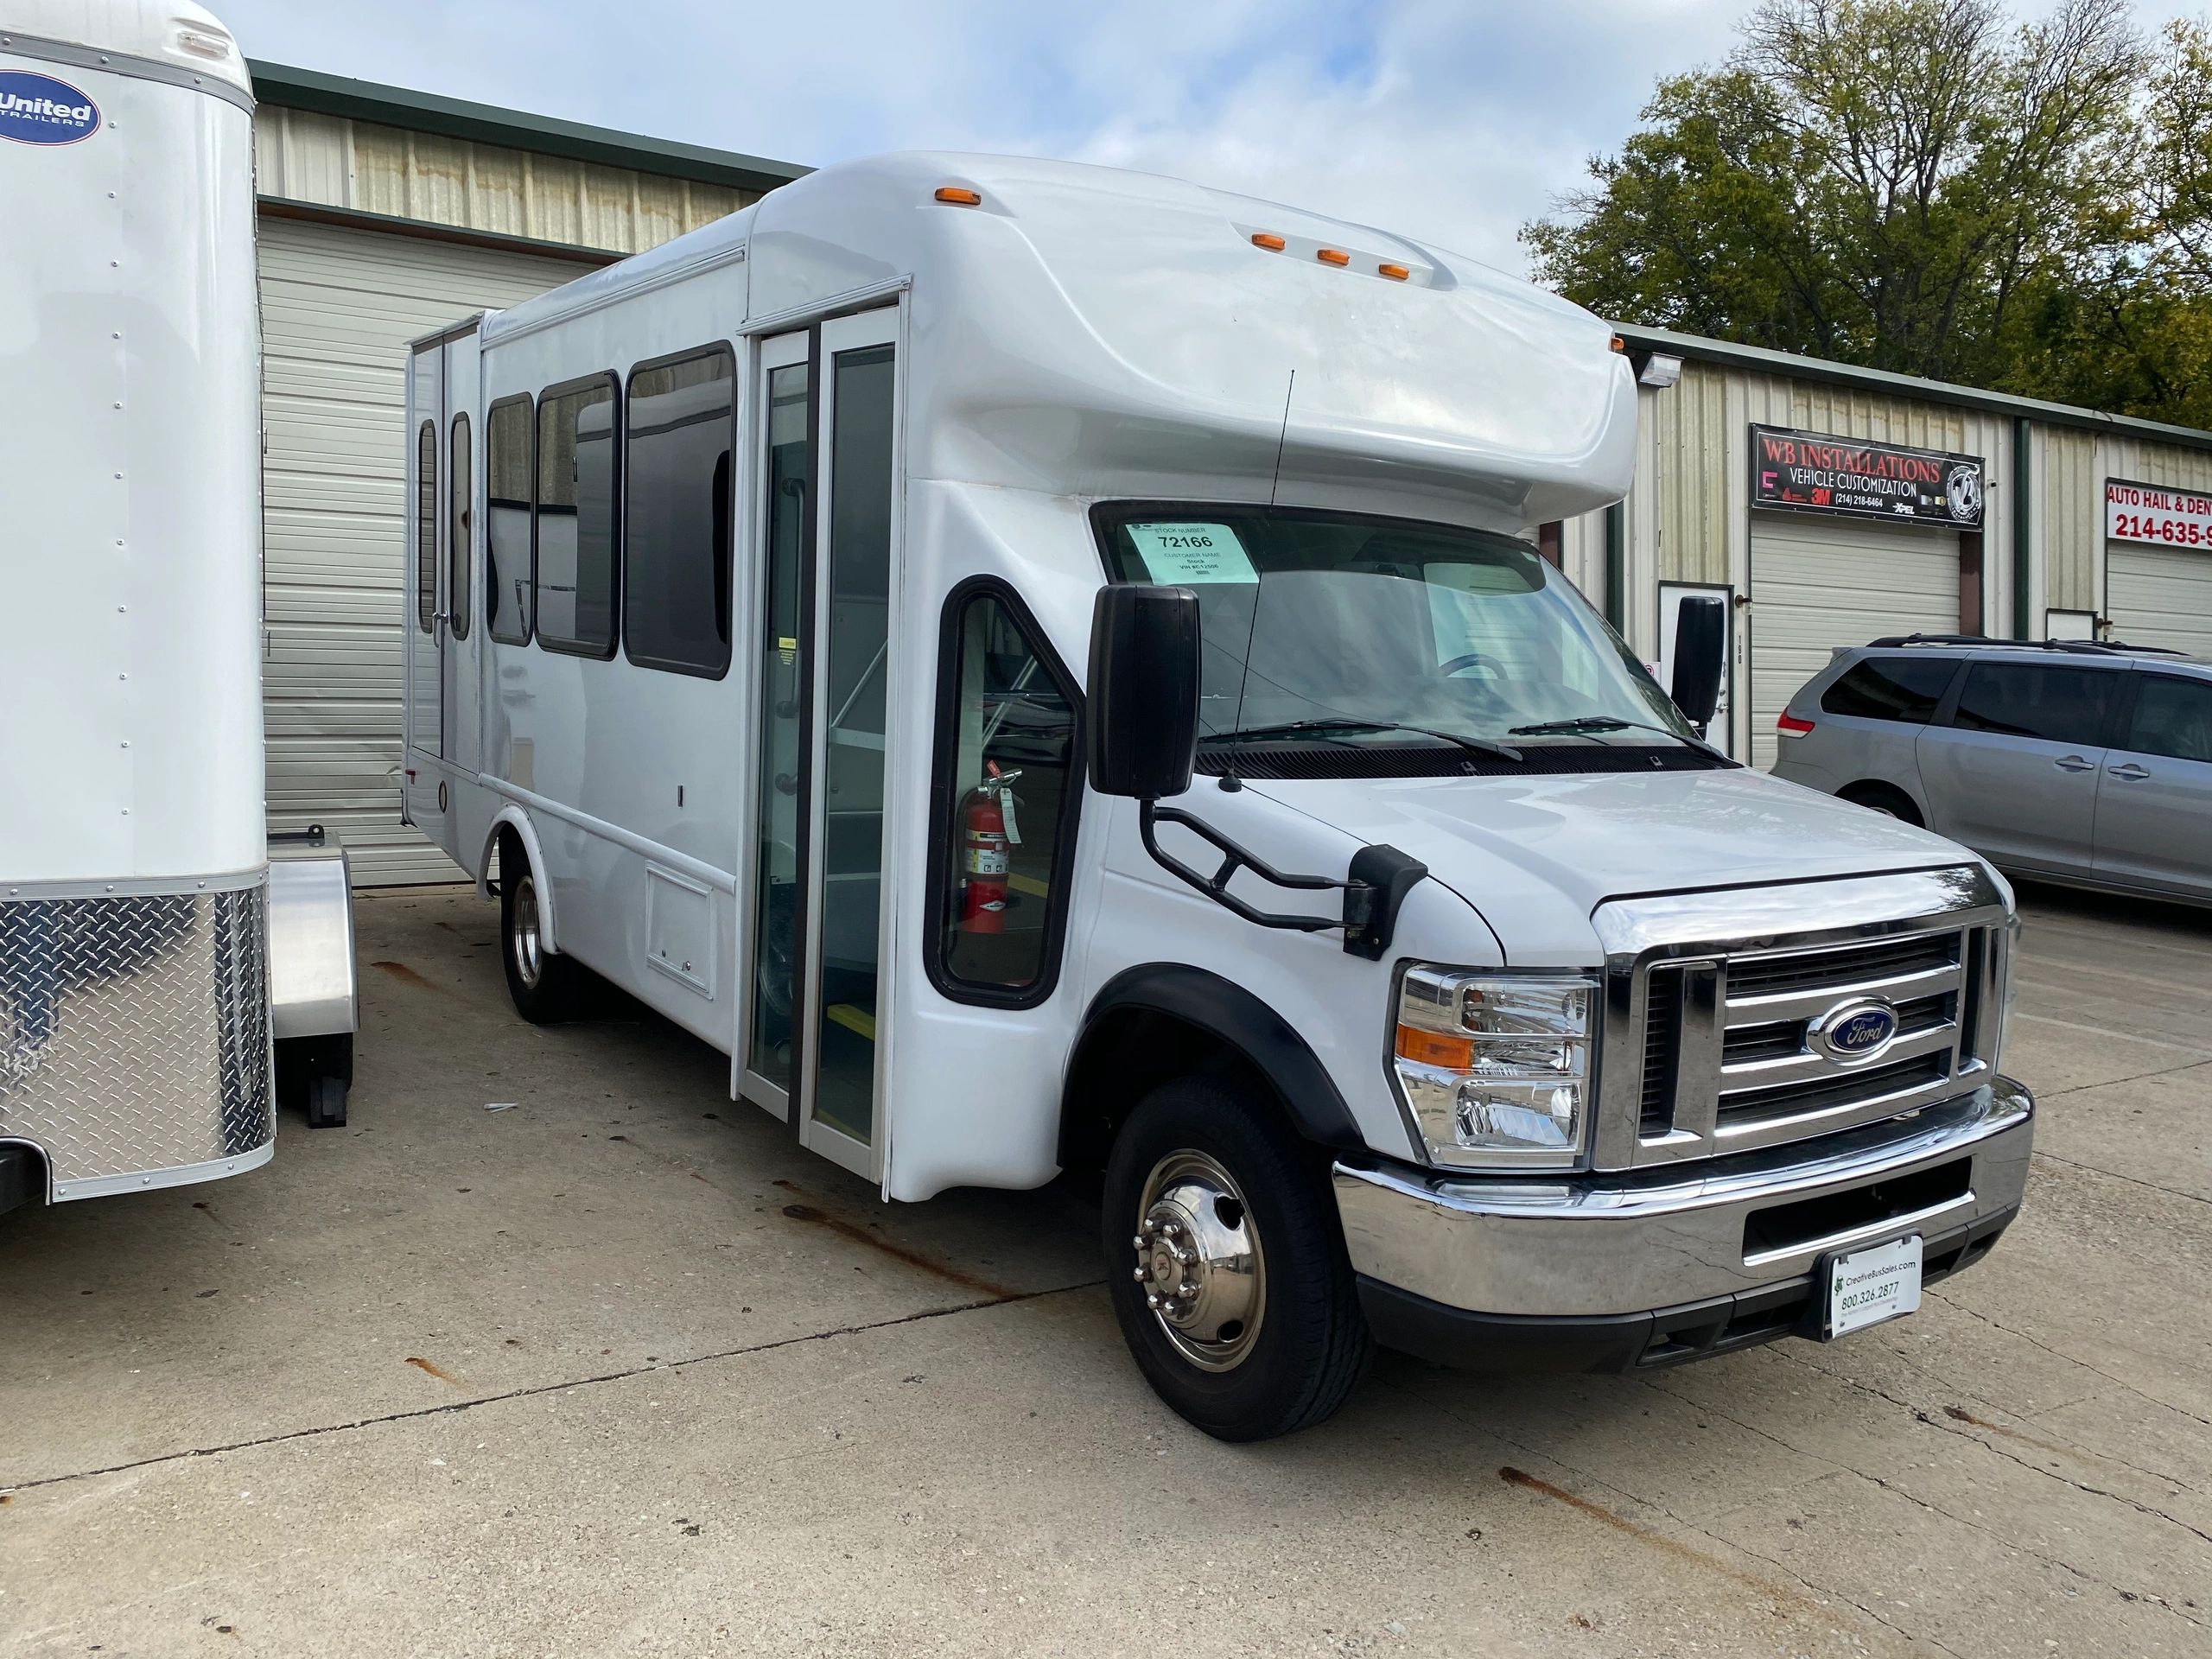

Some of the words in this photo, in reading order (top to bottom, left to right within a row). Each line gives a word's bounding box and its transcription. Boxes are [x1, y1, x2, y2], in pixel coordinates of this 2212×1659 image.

[0, 92, 92, 121] United
[0, 110, 85, 127] TRAILERS
[1763, 438, 1796, 465] WB
[1800, 443, 1941, 484] INSTALLATIONS
[1789, 467, 1834, 489] VEHICLE
[1837, 473, 1917, 498] CUSTOMIZATION
[1811, 487, 1831, 505] 3M
[1835, 493, 1853, 505] (214)
[1853, 494, 1883, 508] 218-6464
[2107, 486, 2140, 506] AUTO
[2143, 491, 2171, 512] HAIL
[2175, 496, 2184, 512] &
[2187, 498, 2212, 517] DEN
[1158, 536, 1213, 548] 72166
[1847, 1015, 1885, 1045] Ford
[1846, 1260, 1916, 1287] CreativeBusSales.com
[1841, 1281, 1899, 1311] 800.326.2877
